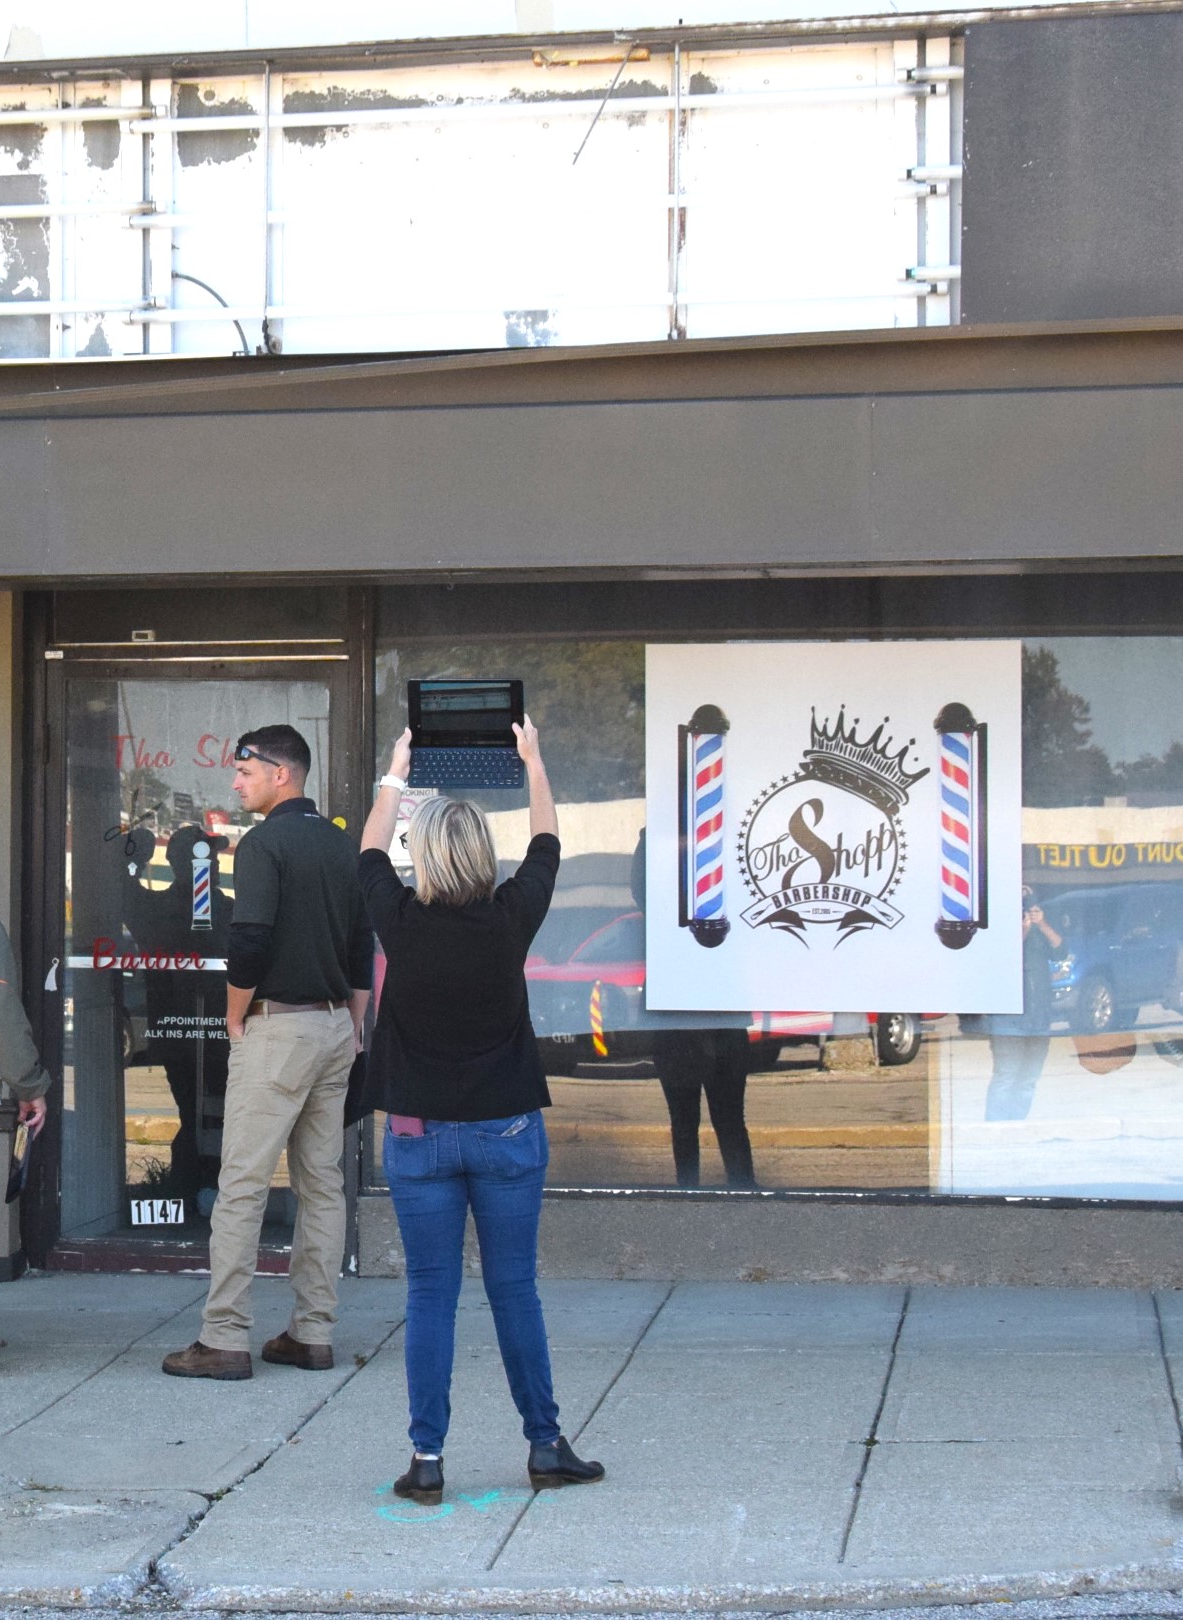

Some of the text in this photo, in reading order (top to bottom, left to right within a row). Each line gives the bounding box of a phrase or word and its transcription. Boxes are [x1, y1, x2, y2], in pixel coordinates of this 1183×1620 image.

[111, 734, 175, 769] Tha
[404, 789, 431, 797] OKING
[748, 798, 895, 891] Tha Shopp
[771, 885, 872, 910] BARBERSHOP
[92, 936, 206, 971] Barber
[140, 1030, 163, 1038] ALK
[166, 1030, 183, 1039] INS
[185, 1030, 205, 1039] ARE
[135, 1200, 182, 1223] 1147
